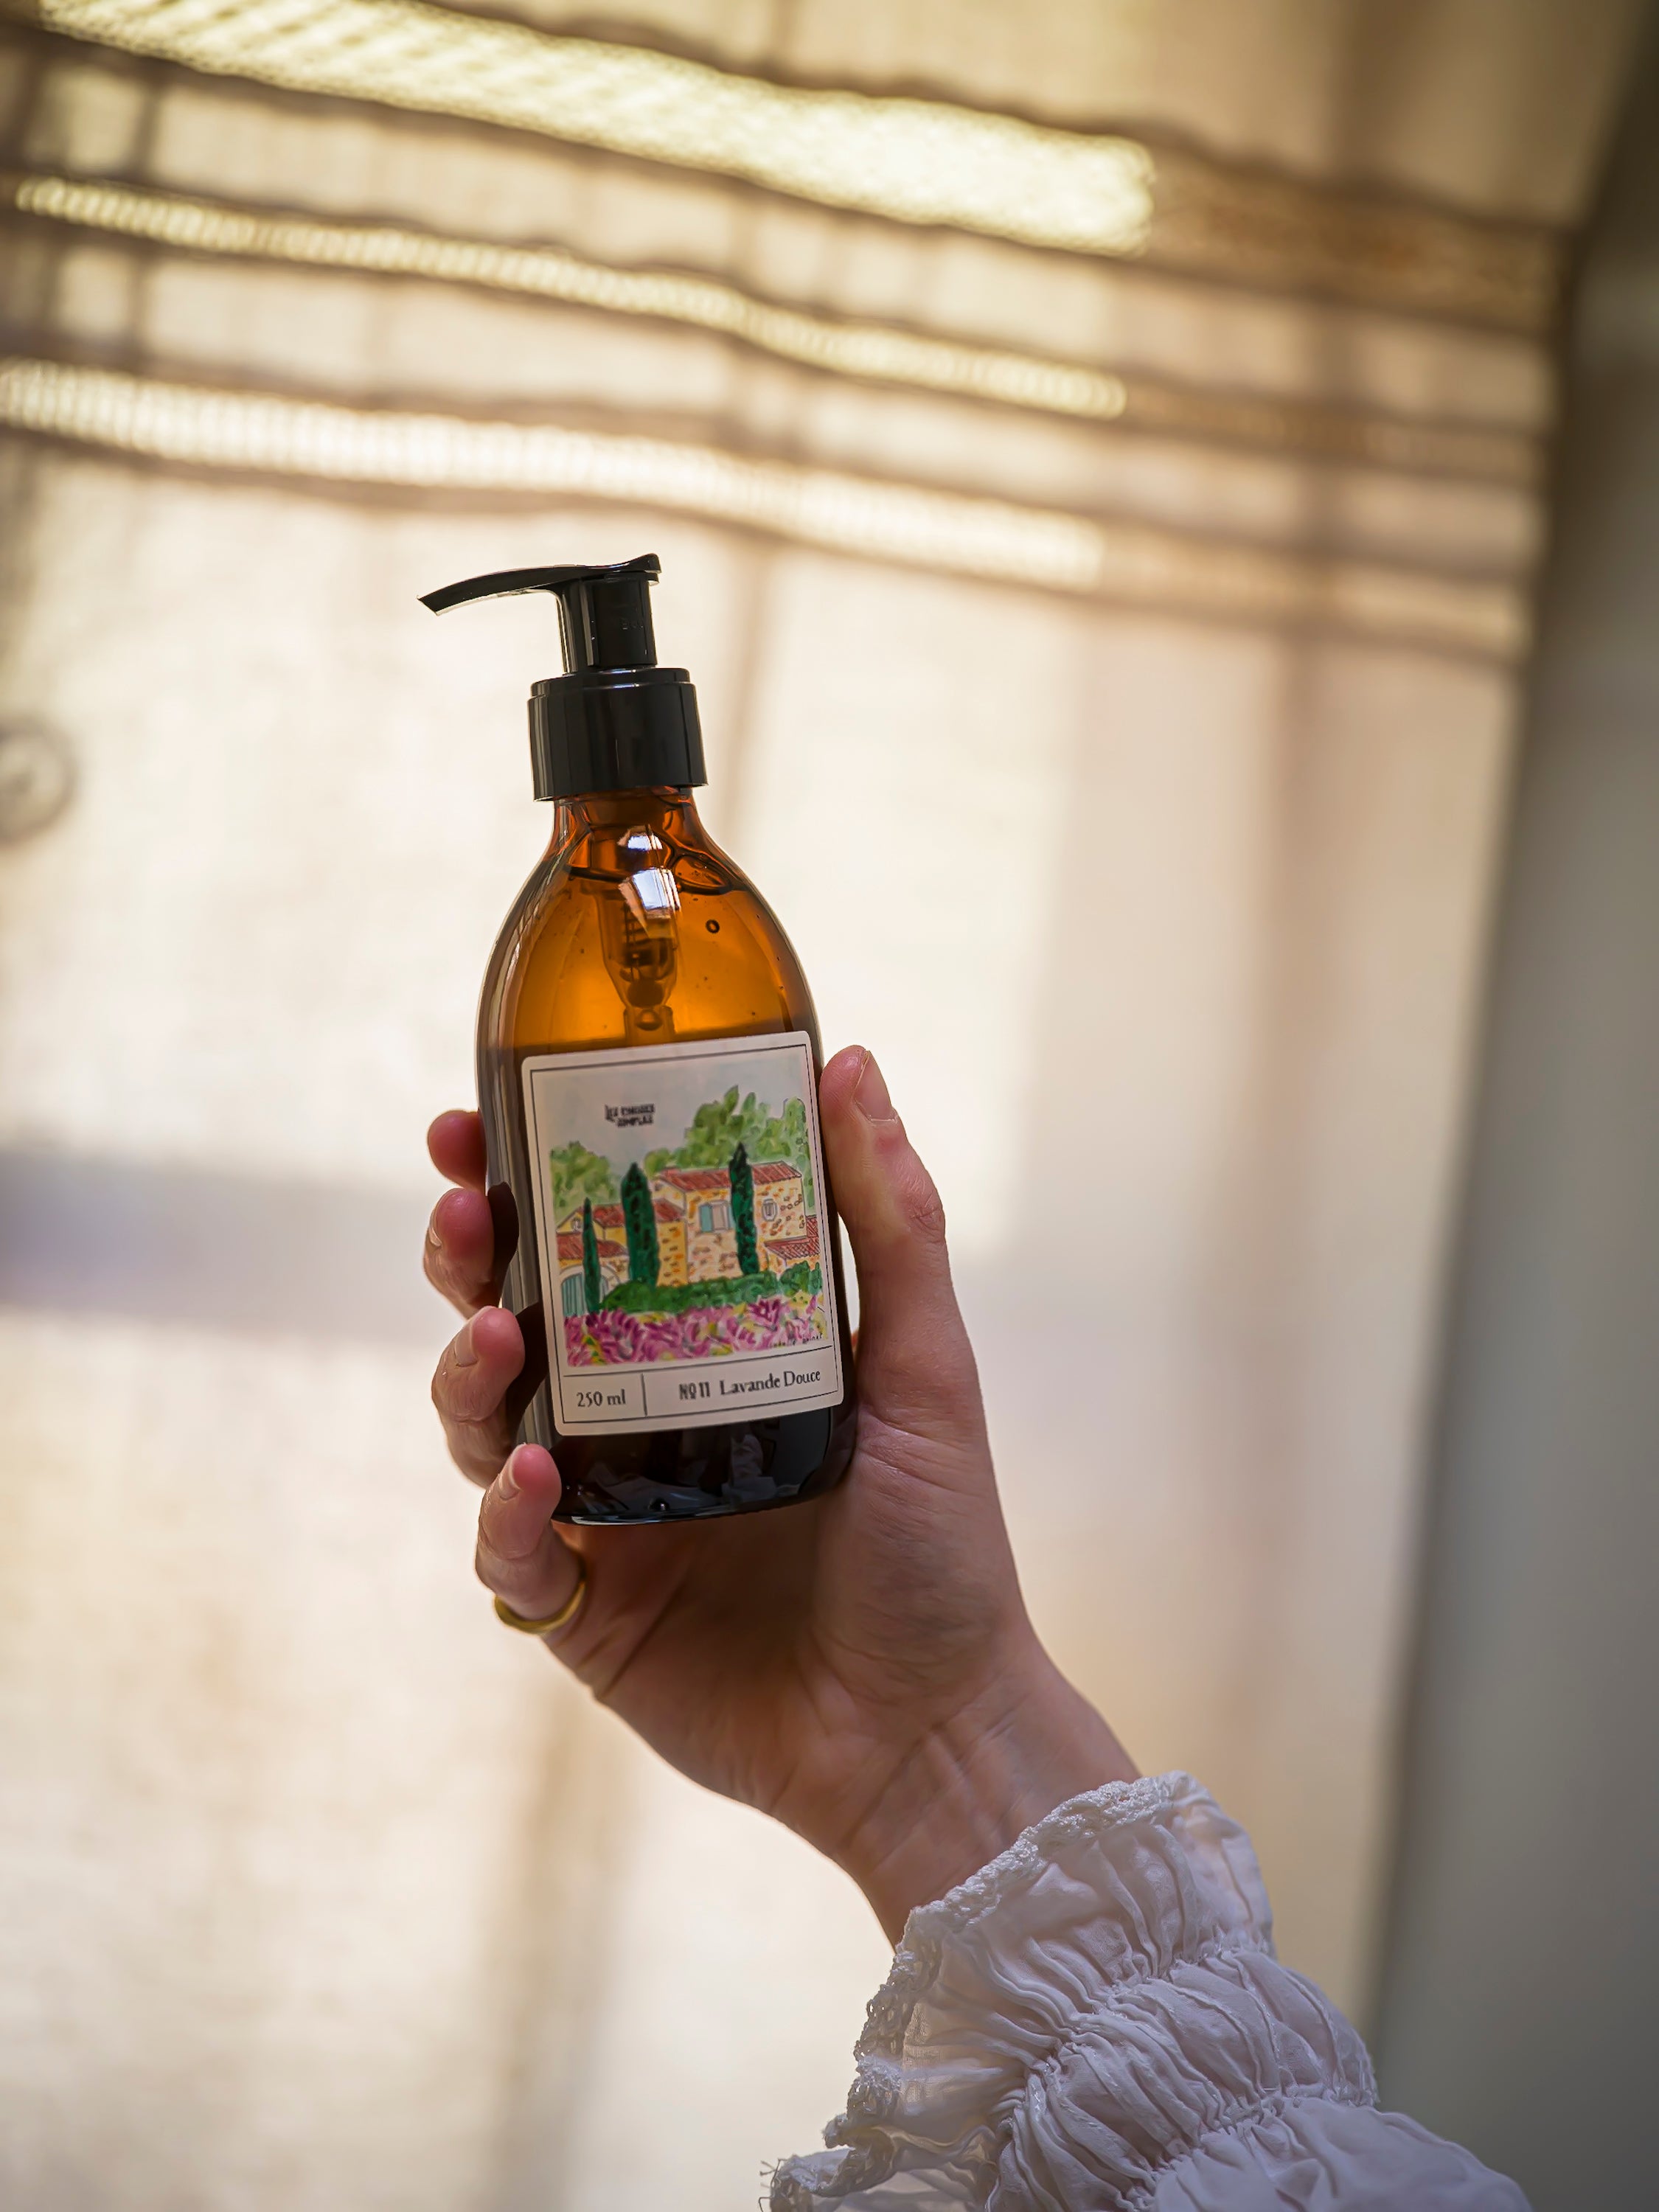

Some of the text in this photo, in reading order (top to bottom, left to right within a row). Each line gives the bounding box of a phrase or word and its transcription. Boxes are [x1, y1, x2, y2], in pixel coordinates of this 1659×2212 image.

[719, 1372, 781, 1395] Lavande
[783, 1370, 821, 1387] Douce
[576, 1388, 626, 1408] 250 ml
